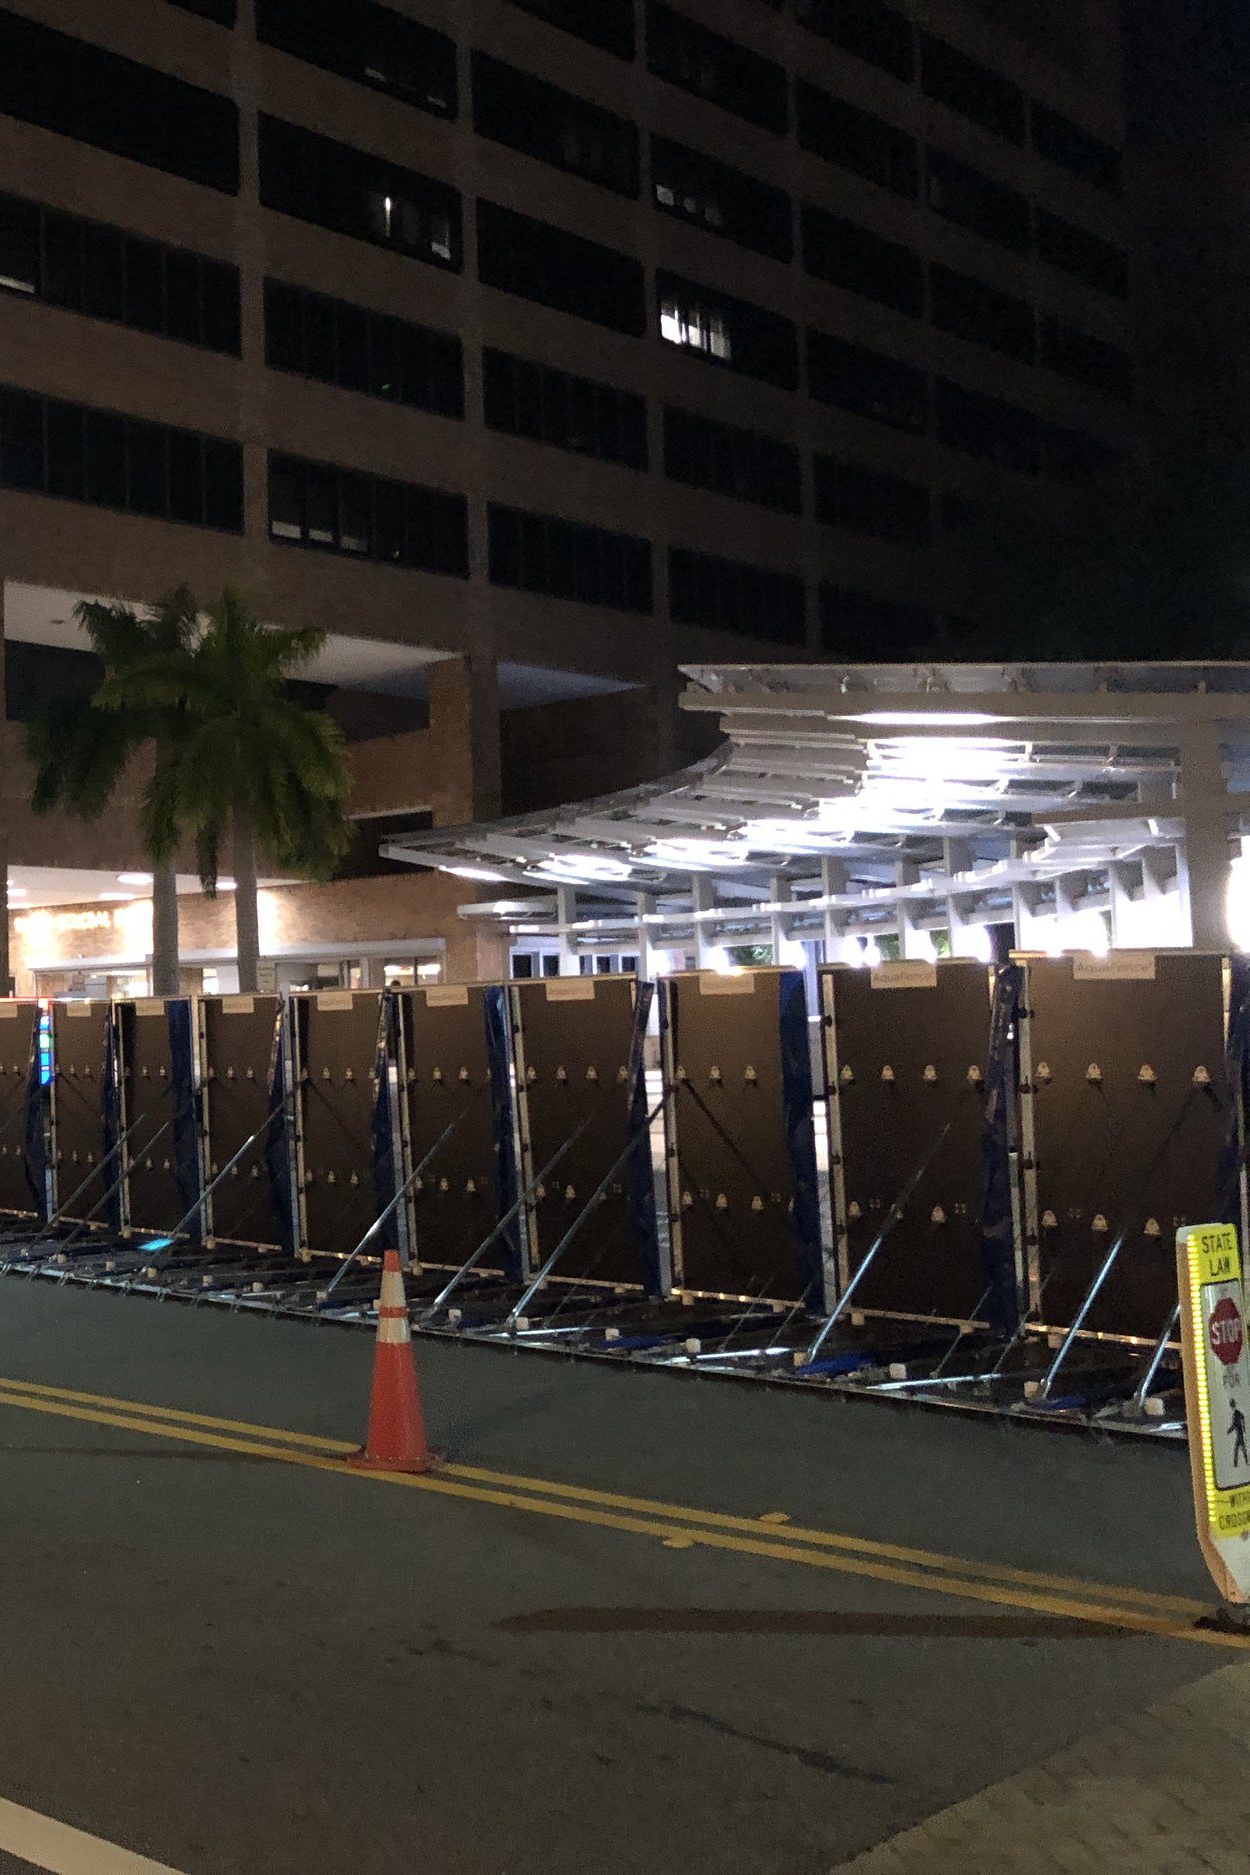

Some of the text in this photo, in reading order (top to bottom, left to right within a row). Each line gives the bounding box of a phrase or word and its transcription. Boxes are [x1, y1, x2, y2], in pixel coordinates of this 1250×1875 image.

[1201, 1232, 1232, 1254] STATE
[1209, 1256, 1230, 1277] LAW
[1211, 1318, 1241, 1345] STOP
